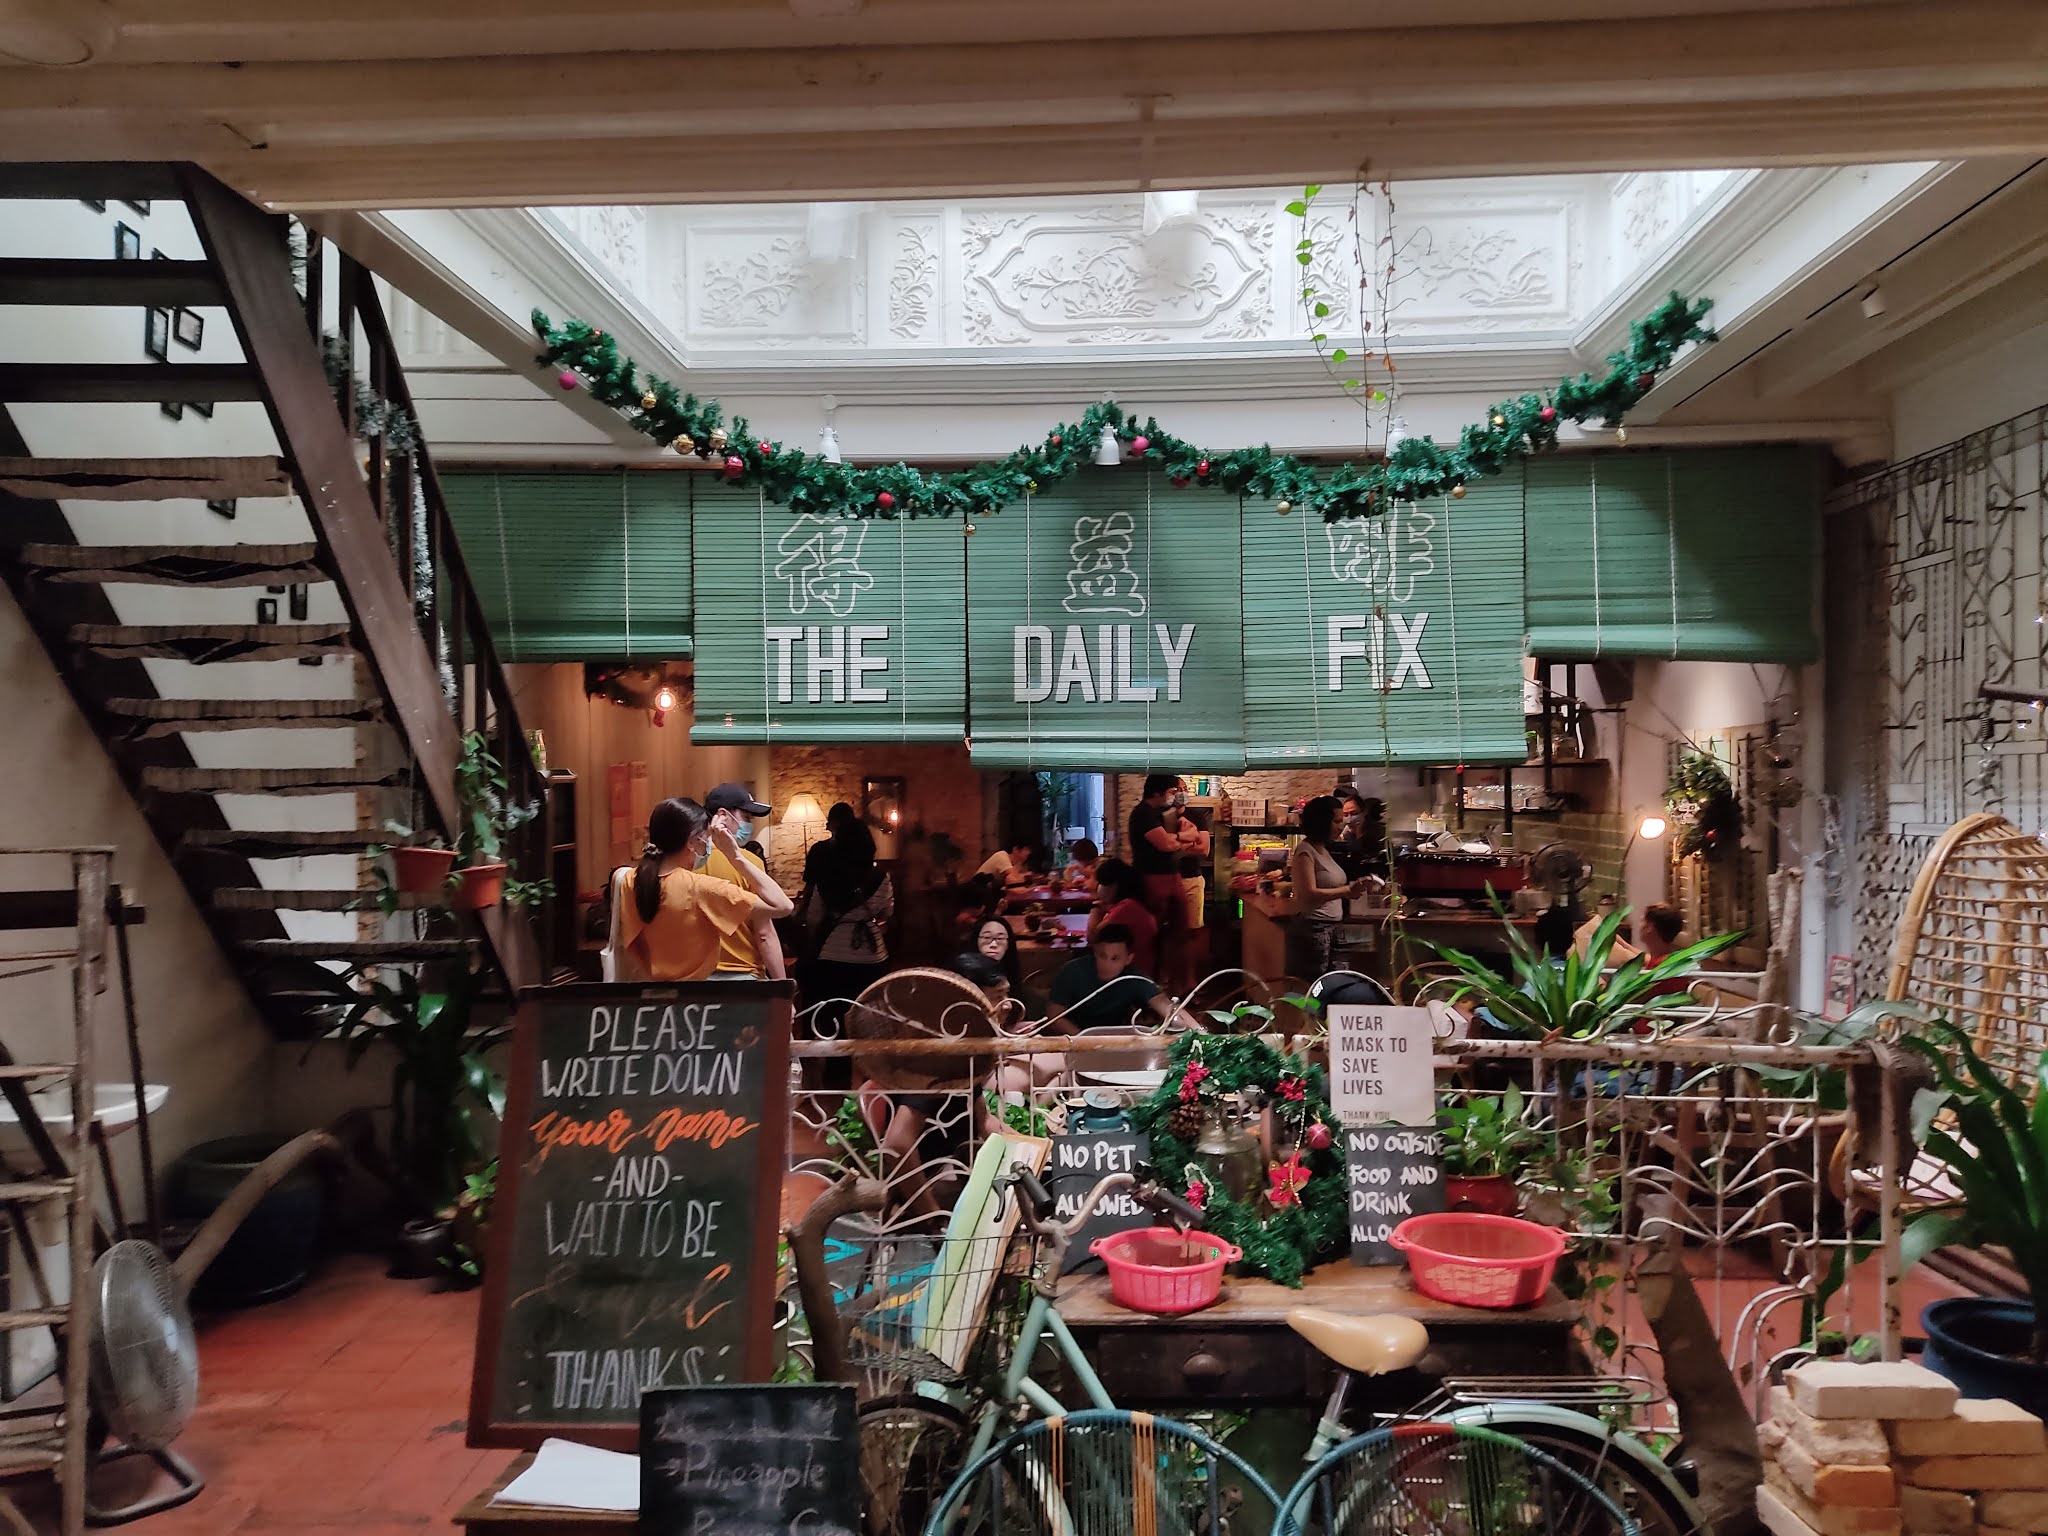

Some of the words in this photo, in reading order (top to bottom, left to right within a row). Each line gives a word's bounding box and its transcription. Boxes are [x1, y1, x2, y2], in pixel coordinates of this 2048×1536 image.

[766, 626, 889, 704] THE
[1014, 623, 1196, 703] DAILY
[1328, 612, 1434, 692] FIX
[587, 1003, 722, 1053] PLEASE
[1340, 1015, 1383, 1031] WEAR
[1341, 1036, 1384, 1053] MASK
[1390, 1037, 1407, 1053] TO
[541, 1053, 644, 1098] WRITE
[649, 1050, 744, 1097] DOWN
[1342, 1058, 1379, 1074] SAVE
[1343, 1079, 1383, 1095] LIVES
[1343, 1110, 1370, 1120] THANK
[1374, 1111, 1390, 1121] YOU
[636, 1106, 760, 1153] name
[1348, 1132, 1380, 1152] NO
[1059, 1143, 1089, 1168] NO
[1093, 1140, 1136, 1171] PET
[1349, 1163, 1391, 1186] FOOD
[1400, 1165, 1438, 1185] AND
[546, 1200, 634, 1257] WAIT
[638, 1200, 676, 1257] TO
[681, 1200, 723, 1259] BE
[1350, 1223, 1393, 1243] ALLO
